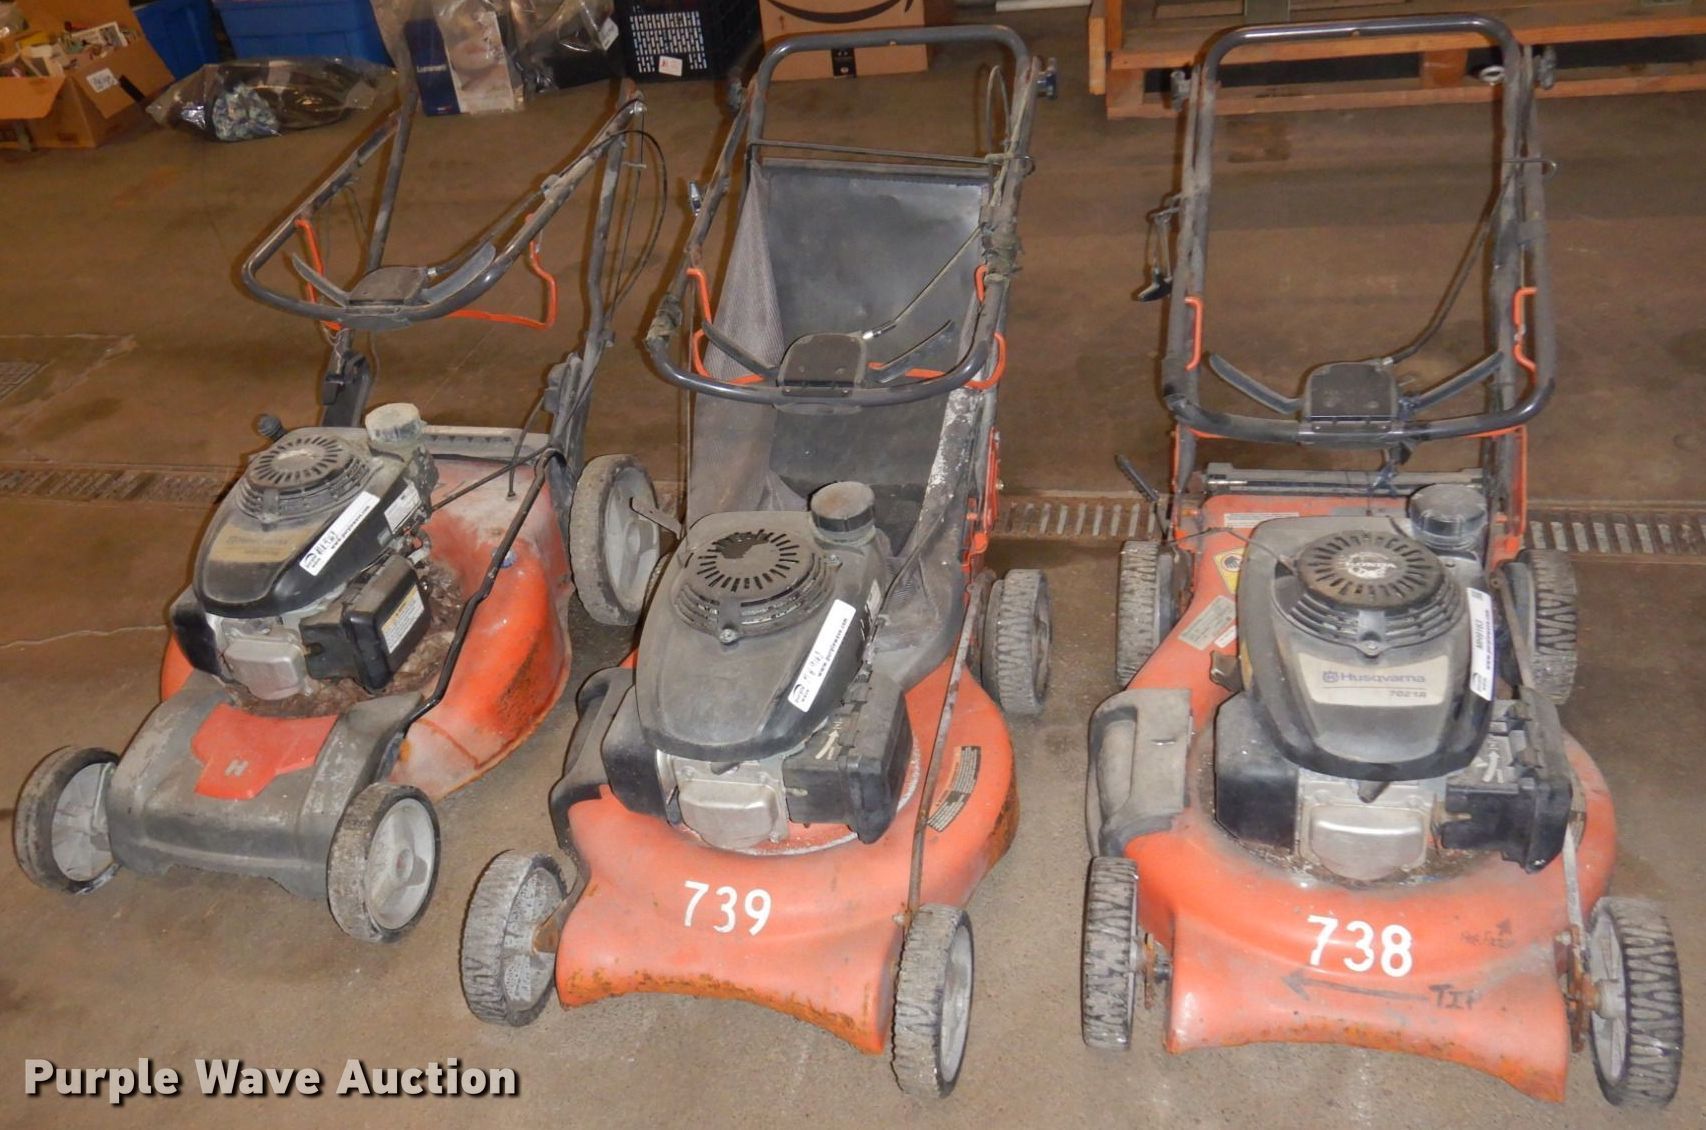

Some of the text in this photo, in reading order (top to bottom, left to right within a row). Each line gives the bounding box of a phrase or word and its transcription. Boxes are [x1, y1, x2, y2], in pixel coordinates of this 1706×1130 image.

[1340, 672, 1426, 684] Husqvarna
[684, 879, 772, 936] 739
[1307, 914, 1413, 978] 738
